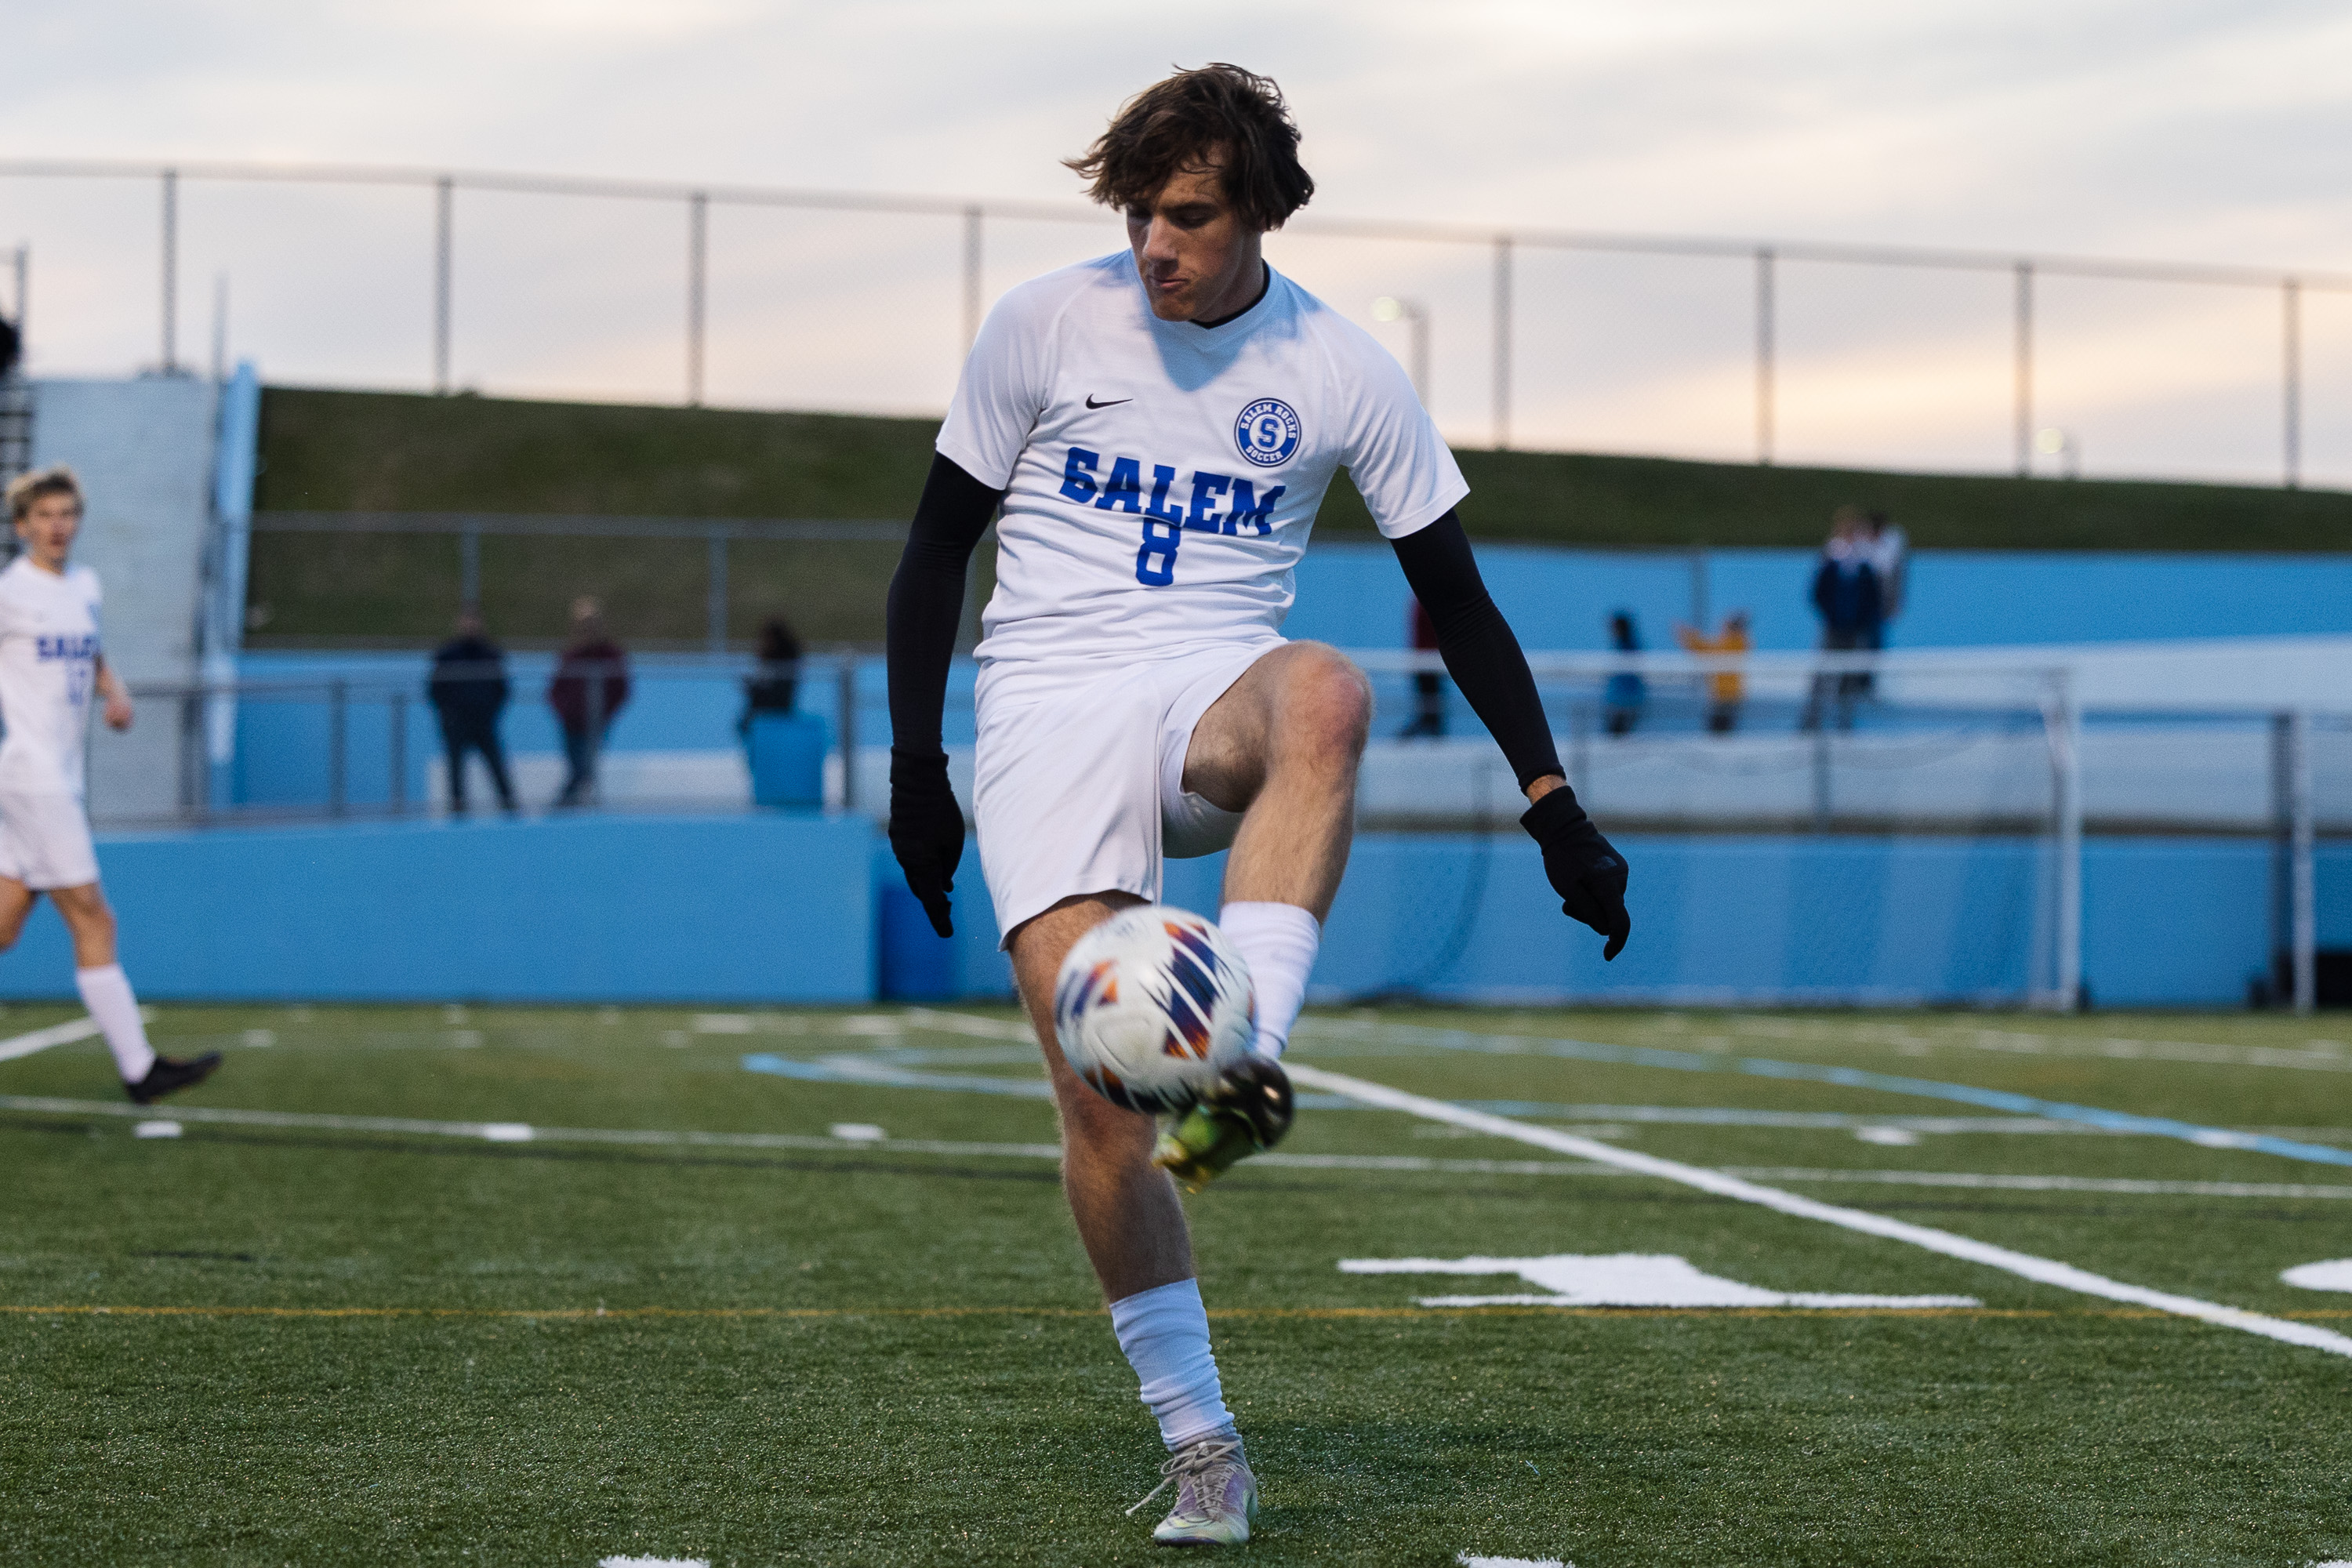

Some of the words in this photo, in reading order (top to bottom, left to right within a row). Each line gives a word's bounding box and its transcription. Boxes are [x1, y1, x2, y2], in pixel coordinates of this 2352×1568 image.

[1240, 404, 1272, 430] SALEM
[1274, 405, 1297, 439] ROCKS
[1258, 416, 1279, 450] S
[1245, 445, 1283, 462] SOCCER
[1059, 447, 1287, 536] SALEM
[1135, 517, 1181, 586] 8
